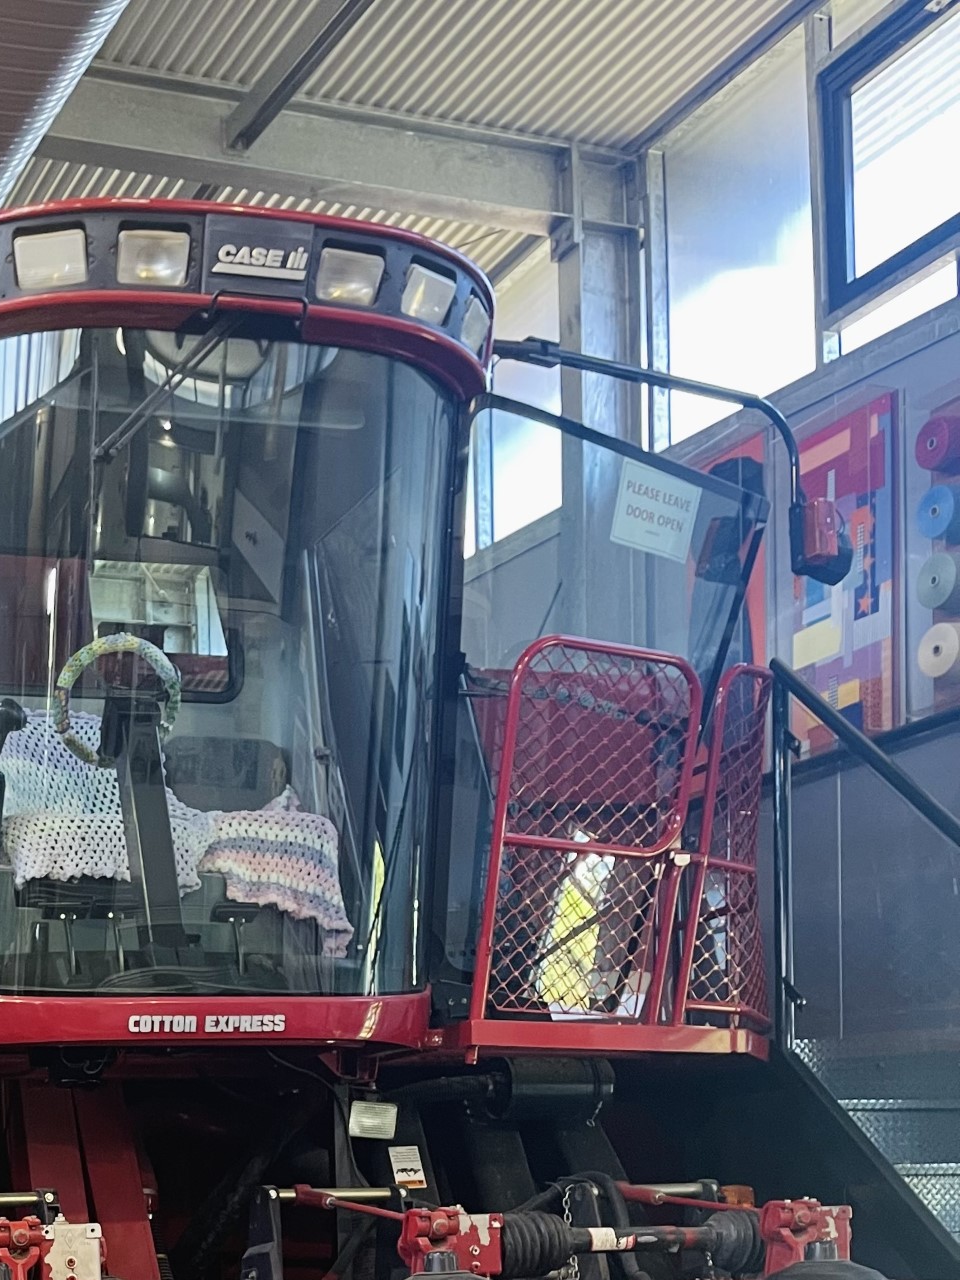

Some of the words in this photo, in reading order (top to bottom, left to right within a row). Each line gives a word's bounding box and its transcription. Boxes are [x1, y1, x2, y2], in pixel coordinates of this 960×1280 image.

[218, 244, 284, 267] CASE
[626, 480, 661, 502] PLEASE
[662, 493, 691, 513] LEAVE
[626, 504, 655, 524] DOOR
[657, 514, 685, 533] OPEN
[128, 1015, 197, 1033] COTTON
[204, 1014, 286, 1032] EXPRESS
